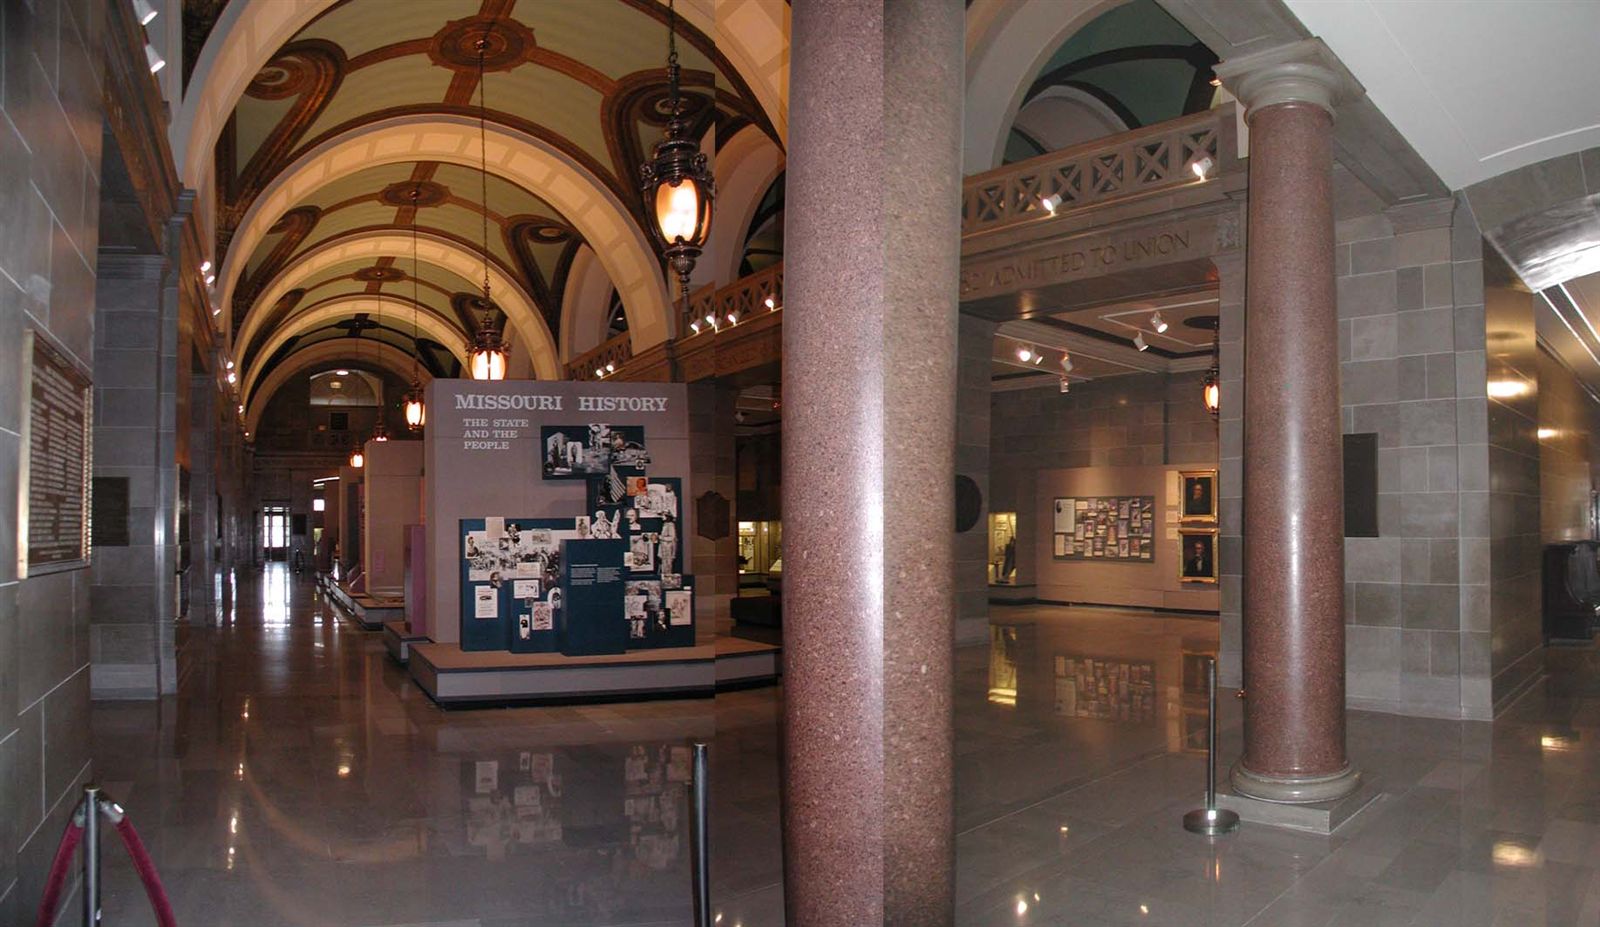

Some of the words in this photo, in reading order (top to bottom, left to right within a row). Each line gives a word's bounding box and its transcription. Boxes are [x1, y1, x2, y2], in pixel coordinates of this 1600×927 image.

[990, 251, 1084, 287] ADMITTED
[1089, 245, 1117, 266] TO
[1124, 230, 1190, 261] UNION
[455, 394, 563, 410] MISSOURI
[578, 396, 668, 412] HISTORY
[463, 418, 488, 427] THE
[493, 419, 529, 428] STATE
[463, 429, 489, 438] AND
[493, 430, 518, 438] THE
[463, 441, 510, 450] PEOPLE
